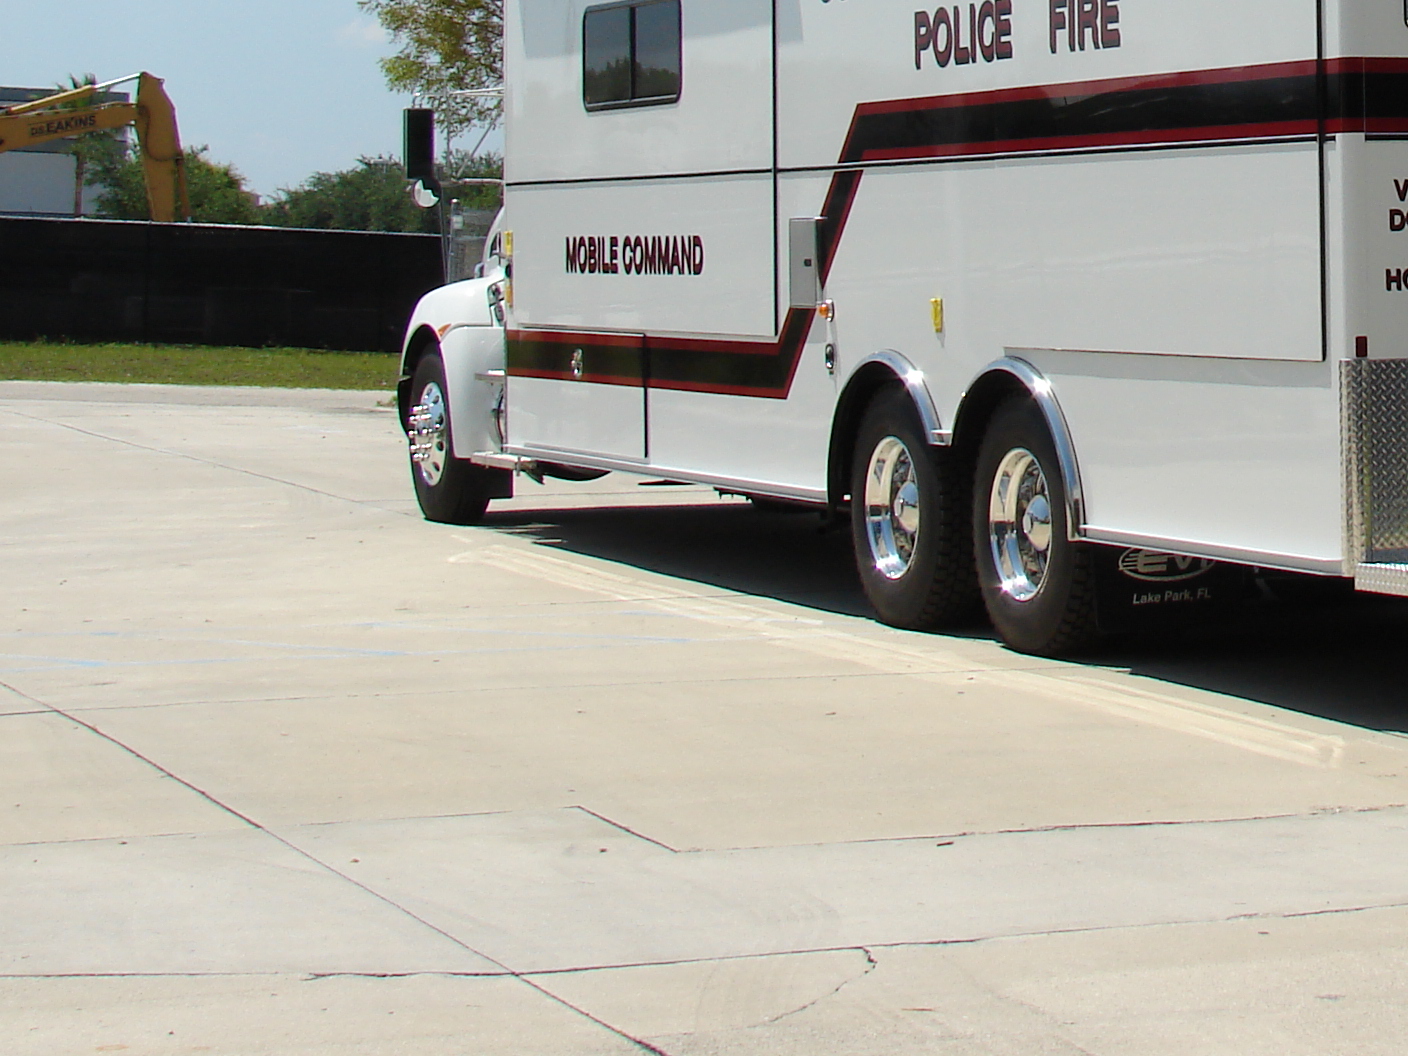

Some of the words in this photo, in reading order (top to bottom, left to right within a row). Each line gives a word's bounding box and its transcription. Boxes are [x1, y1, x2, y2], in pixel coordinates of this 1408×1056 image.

[565, 235, 619, 275] MOBILE
[622, 235, 704, 276] COMMAND
[1132, 592, 1161, 605] Lake
[1164, 589, 1194, 603] Park,
[1197, 587, 1212, 600] FL
